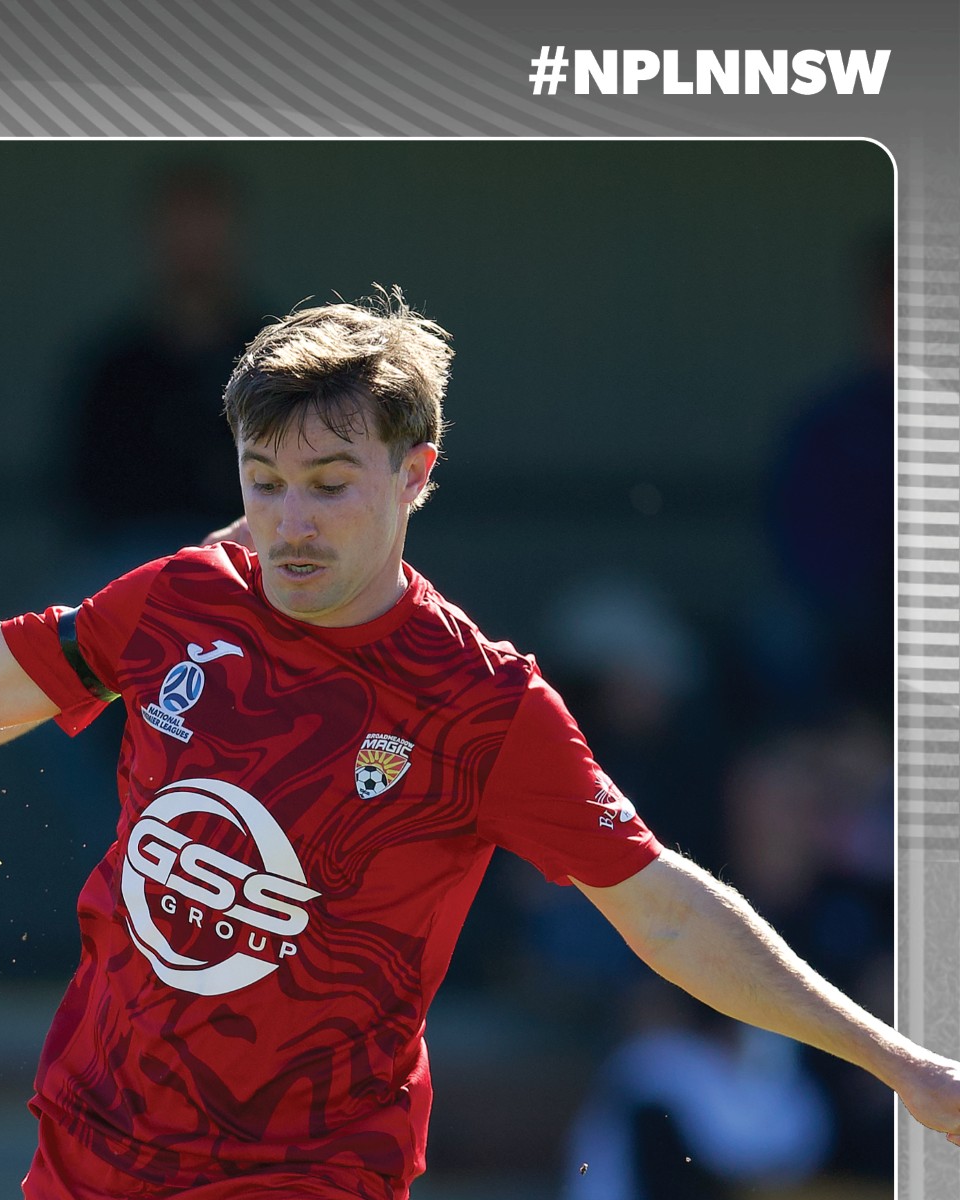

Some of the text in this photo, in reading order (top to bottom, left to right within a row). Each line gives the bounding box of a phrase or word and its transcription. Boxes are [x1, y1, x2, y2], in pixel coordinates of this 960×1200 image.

[148, 706, 181, 727] NATIONAL
[160, 721, 190, 740] LEAGUES
[360, 739, 412, 759] MAGIC
[127, 816, 323, 937] GSS
[160, 894, 298, 959] GROUP
